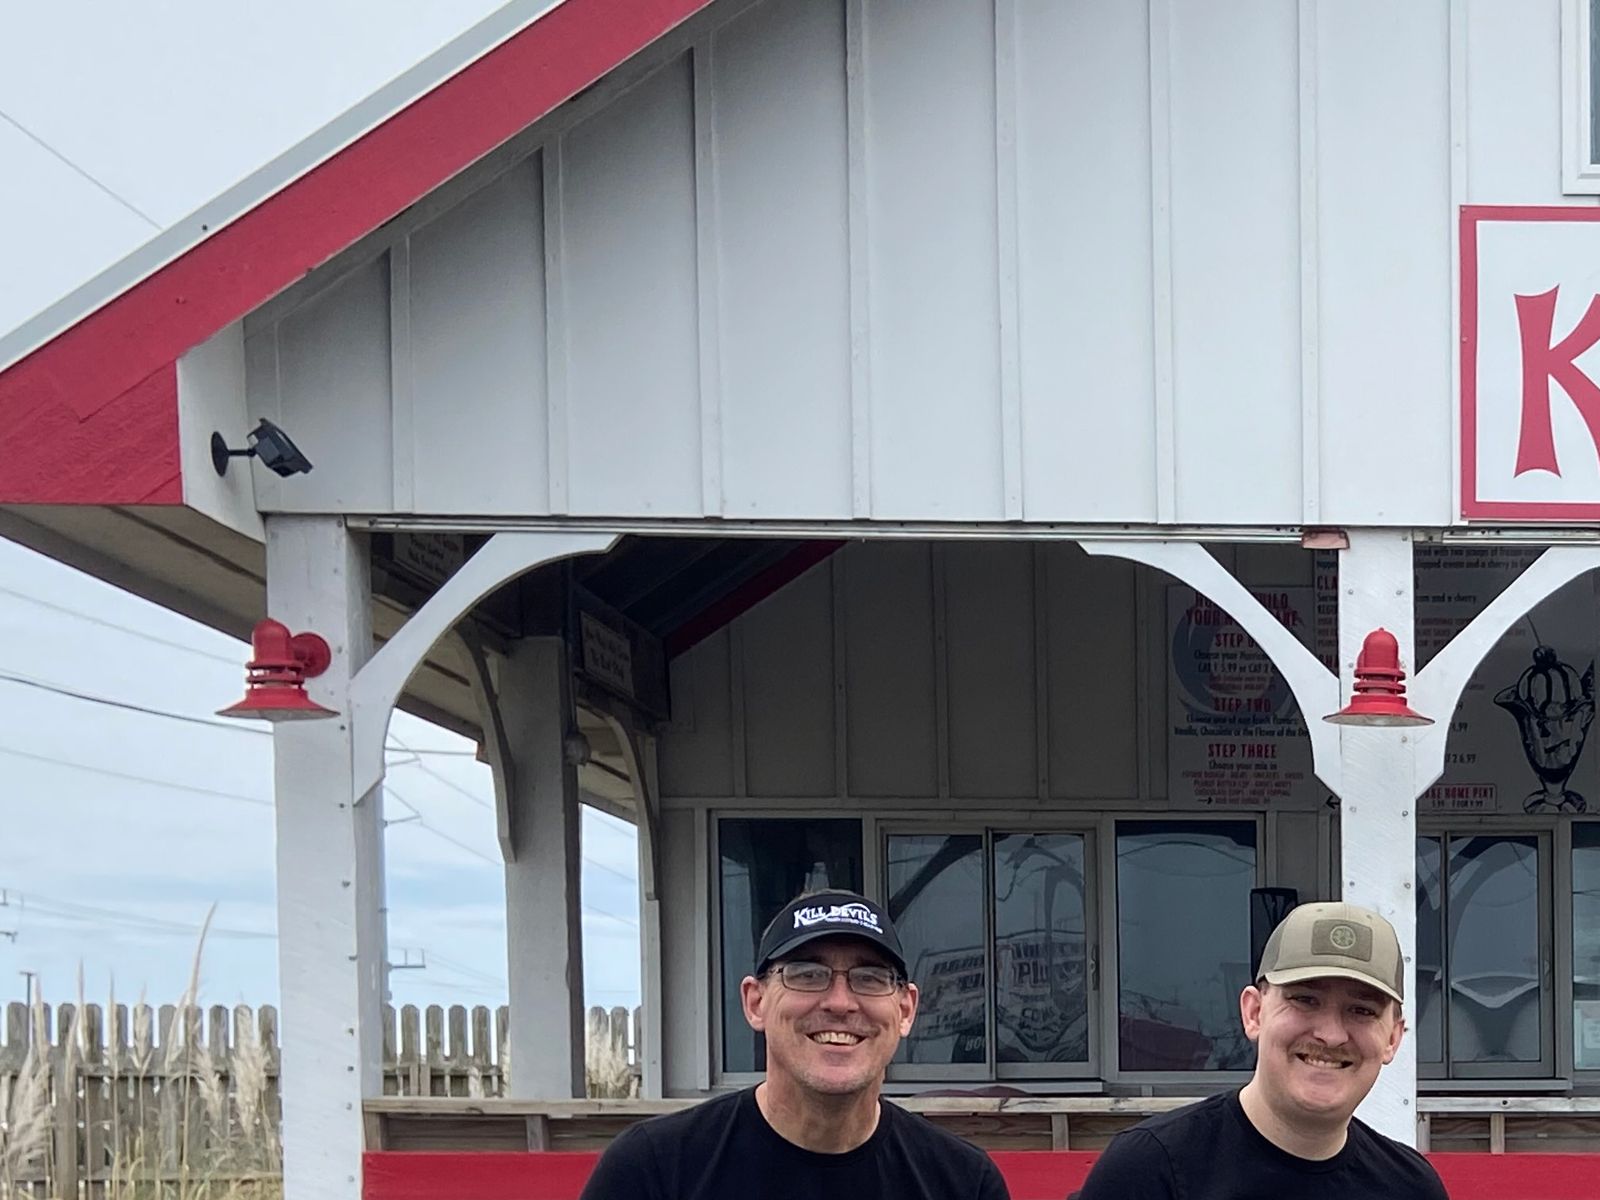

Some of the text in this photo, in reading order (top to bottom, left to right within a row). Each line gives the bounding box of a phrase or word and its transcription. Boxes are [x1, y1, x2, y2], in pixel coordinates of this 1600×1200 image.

[1215, 633, 1244, 648] STEP
[1214, 697, 1271, 712] STEP TWO
[1208, 743, 1277, 758] STEP THREE
[1425, 787, 1441, 799] AKE
[1445, 787, 1469, 799] HOME
[794, 906, 824, 929] KILL
[830, 904, 878, 926] DEVILS
